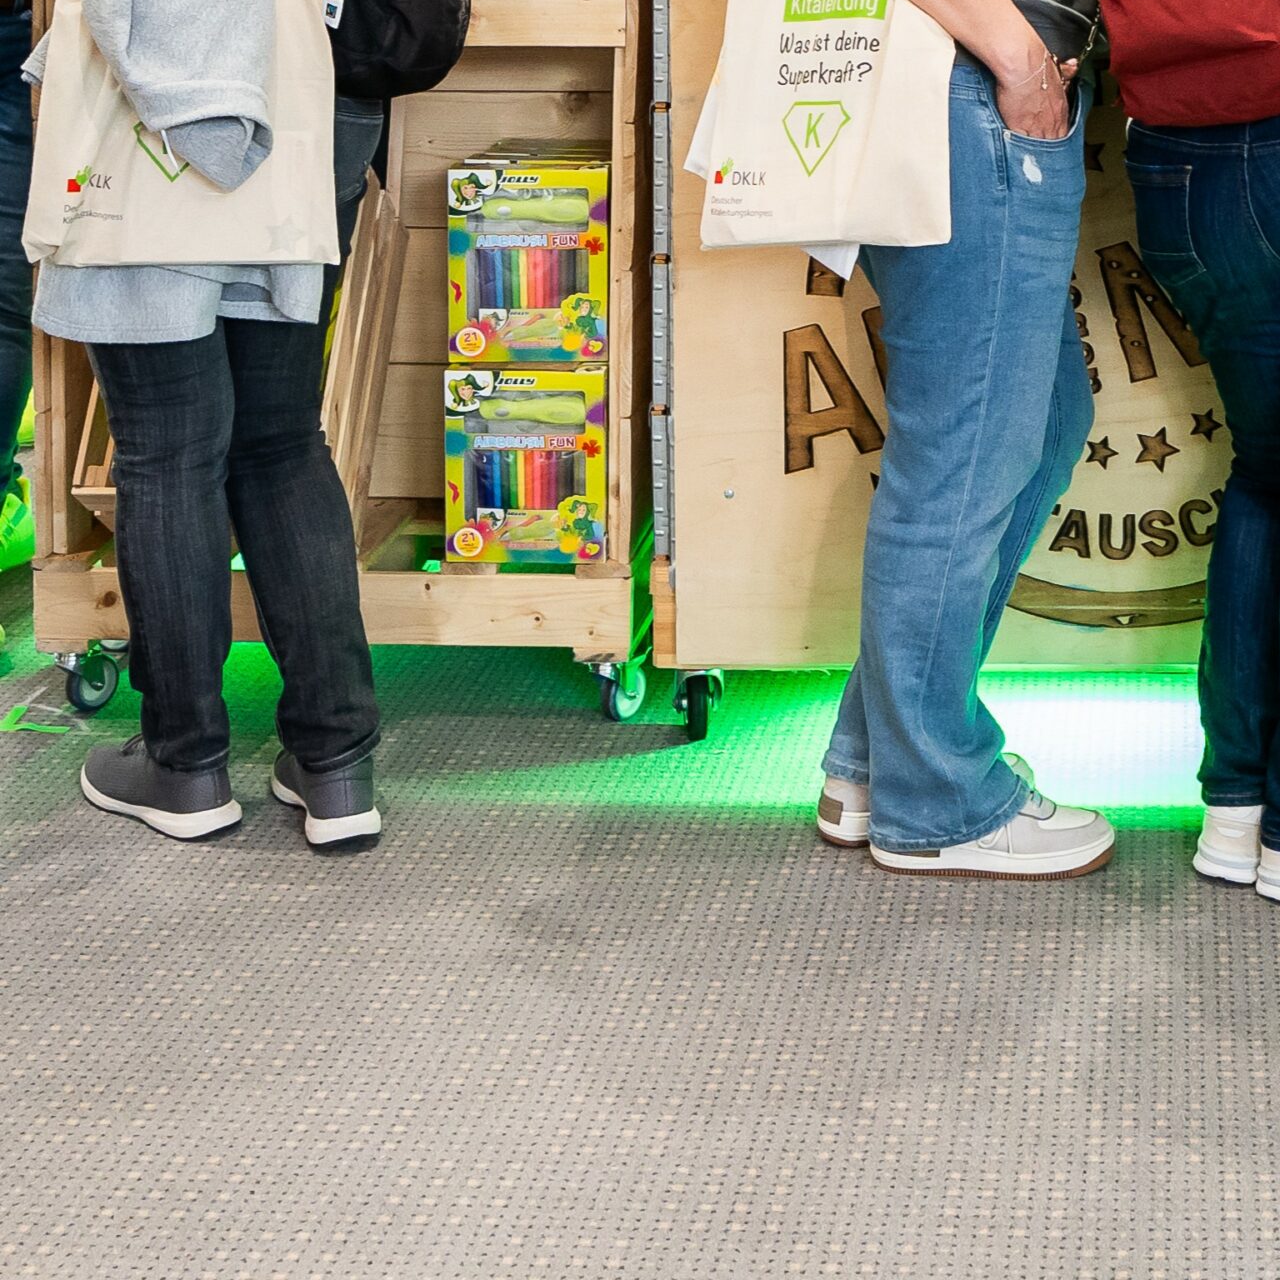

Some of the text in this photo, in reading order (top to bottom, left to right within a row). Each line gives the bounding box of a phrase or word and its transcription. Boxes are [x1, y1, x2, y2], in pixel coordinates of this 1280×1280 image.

[779, 30, 880, 54] Was ist deine
[804, 112, 825, 149] K
[731, 171, 766, 186] DKLK
[551, 235, 579, 247] FUN
